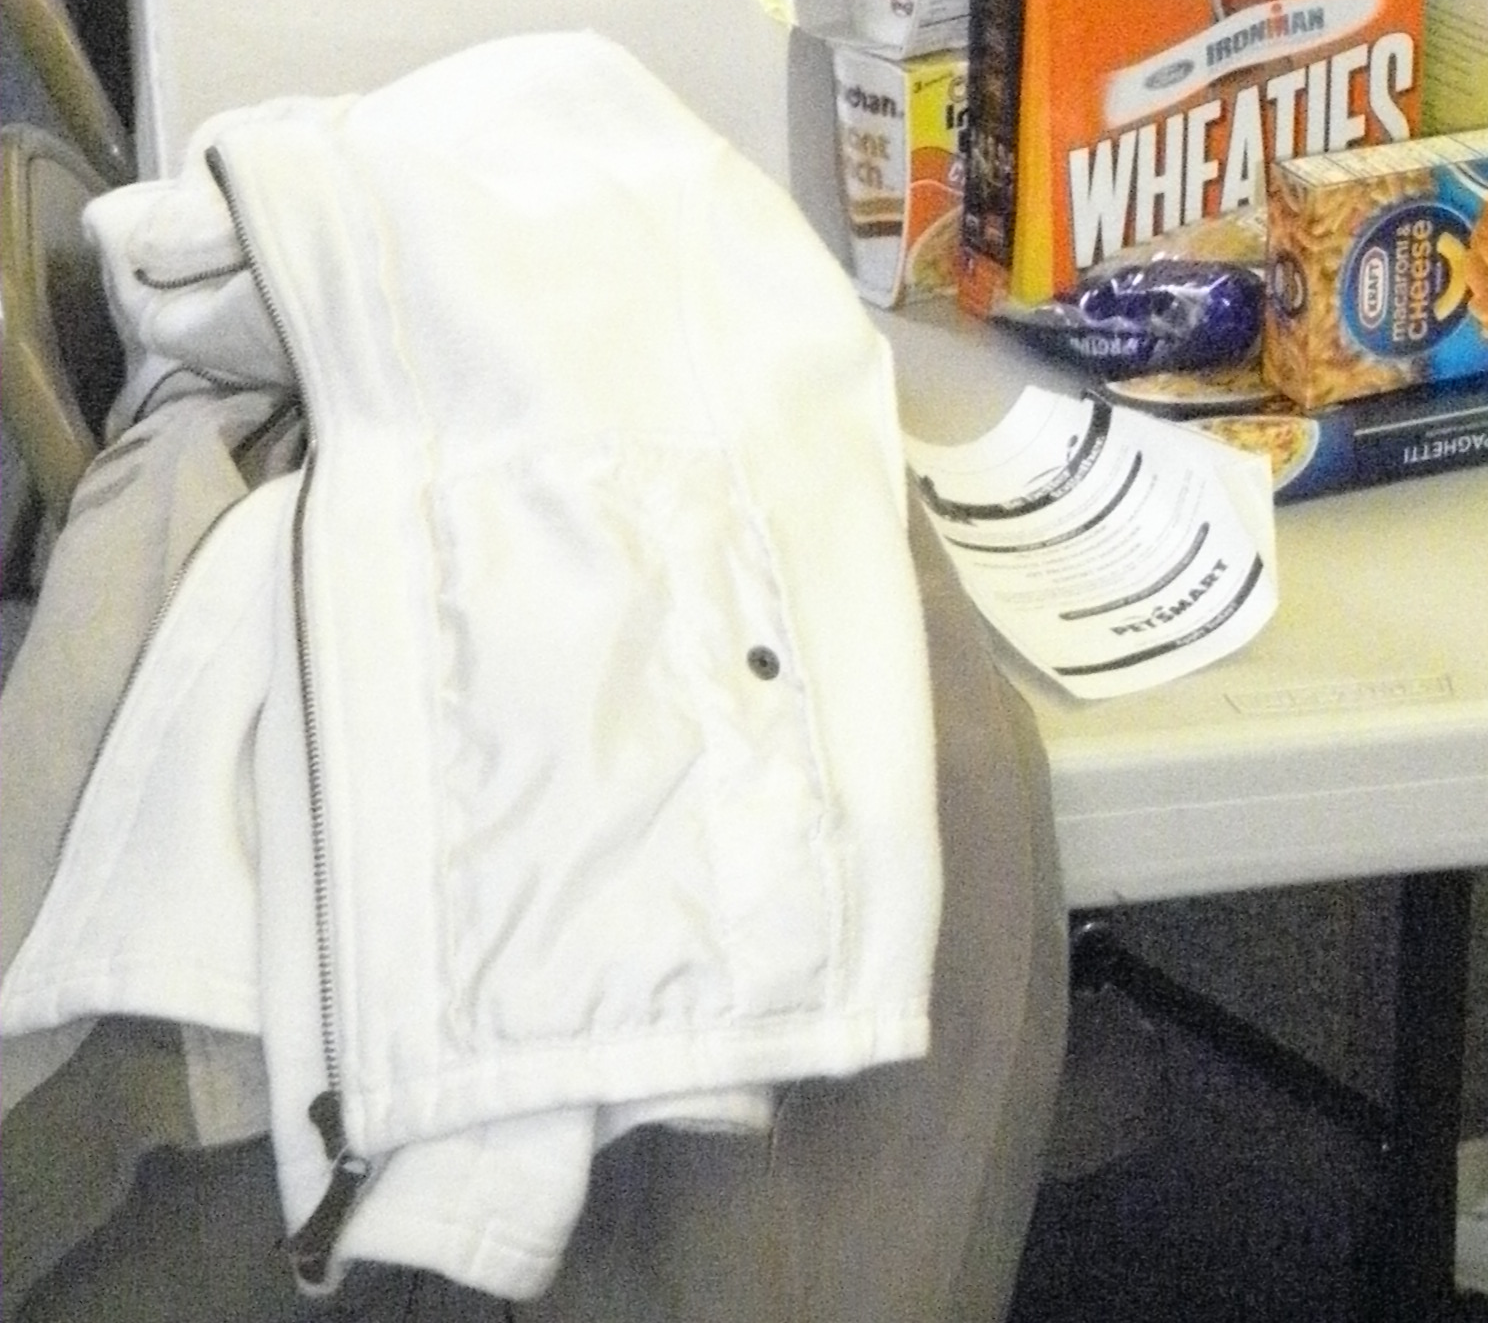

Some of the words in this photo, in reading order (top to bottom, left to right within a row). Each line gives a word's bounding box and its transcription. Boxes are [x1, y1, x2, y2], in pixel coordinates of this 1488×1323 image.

[1206, 3, 1325, 67] IRONMAN
[1069, 32, 1415, 270] WHEATIES
[1396, 223, 1411, 236] &
[1367, 261, 1381, 314] KRAFT
[1392, 239, 1410, 342] macaroni
[1110, 558, 1228, 636] PETSMART
